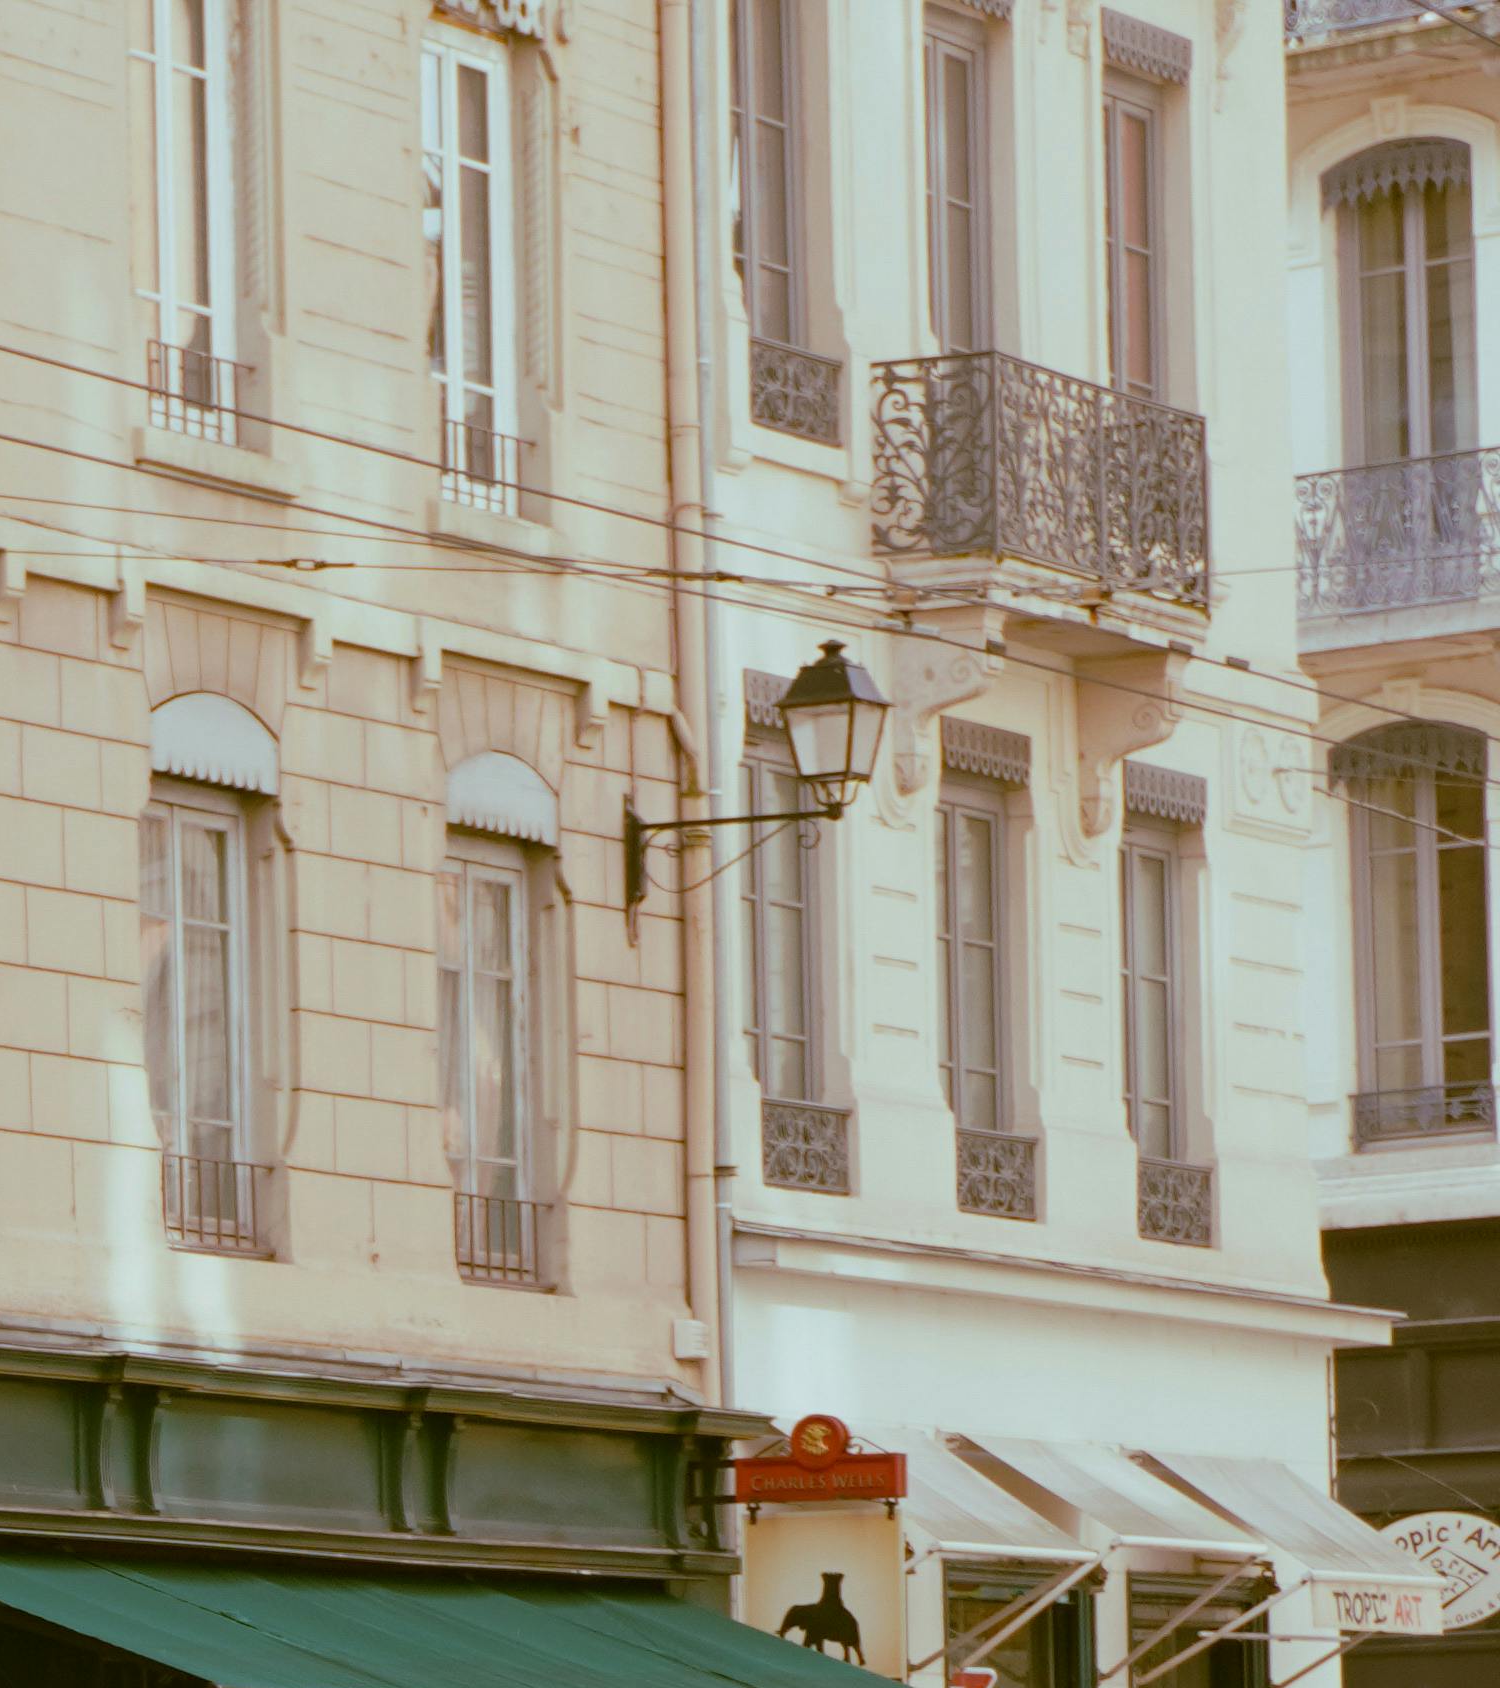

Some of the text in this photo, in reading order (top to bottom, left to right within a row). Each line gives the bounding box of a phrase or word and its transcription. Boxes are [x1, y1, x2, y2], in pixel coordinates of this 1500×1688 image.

[751, 1472, 885, 1492] CHARLES WELLS
[1394, 1595, 1422, 1627] ART
